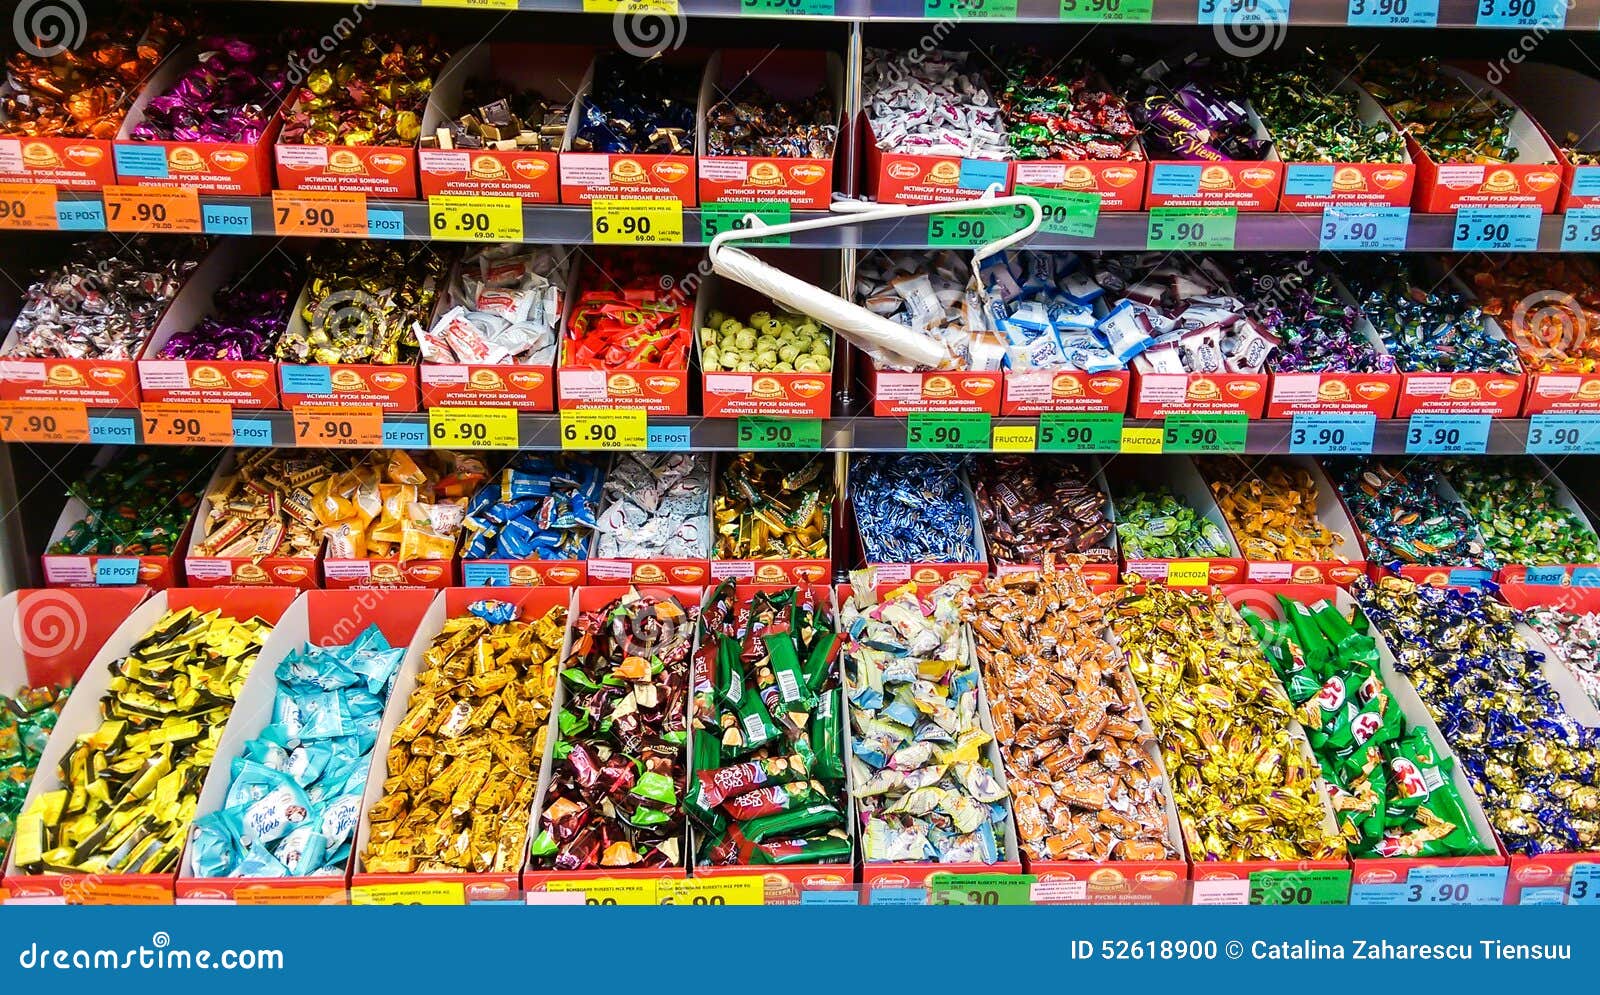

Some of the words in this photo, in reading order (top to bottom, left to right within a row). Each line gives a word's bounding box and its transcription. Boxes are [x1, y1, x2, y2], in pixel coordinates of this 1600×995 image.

[59, 211, 74, 220] DE
[75, 211, 100, 220] POST
[108, 203, 167, 222] 7.90
[207, 215, 220, 224] DE
[223, 216, 248, 225] POST
[277, 207, 334, 227] 7.90
[367, 221, 373, 230] E
[375, 220, 401, 230] POST
[433, 212, 490, 231] 6.90
[596, 216, 651, 234] 6.90
[931, 220, 985, 238] 5.90
[1150, 223, 1204, 240] 5.90
[1323, 223, 1377, 241] 3.90
[1456, 223, 1509, 241] 3.90
[93, 426, 105, 434] DE
[108, 427, 132, 436] POST
[145, 418, 200, 435] 7.90
[244, 428, 267, 437] POST
[297, 421, 353, 438] 7.90
[433, 422, 487, 439] 6.90
[564, 424, 617, 441] 6.90
[740, 426, 791, 442] 5.90
[386, 432, 398, 440] DE
[400, 432, 424, 440] POST
[650, 434, 662, 443] DE
[664, 434, 687, 443] POST
[910, 427, 961, 443] 5.90
[995, 435, 1033, 444] FRUCTOZA
[1042, 427, 1093, 443] 5.90
[1122, 437, 1161, 445] FRUCTOZA
[1165, 428, 1217, 445] 5.90
[1293, 429, 1344, 445] 3.90
[1409, 428, 1459, 444] 3.90
[1529, 428, 1579, 444] 3.90
[100, 568, 111, 576] DE
[113, 568, 136, 576] POST
[1170, 570, 1206, 578] FRUCTOZA
[1527, 574, 1539, 582] DE
[1541, 574, 1562, 582] POST
[1407, 884, 1469, 902] 3.90
